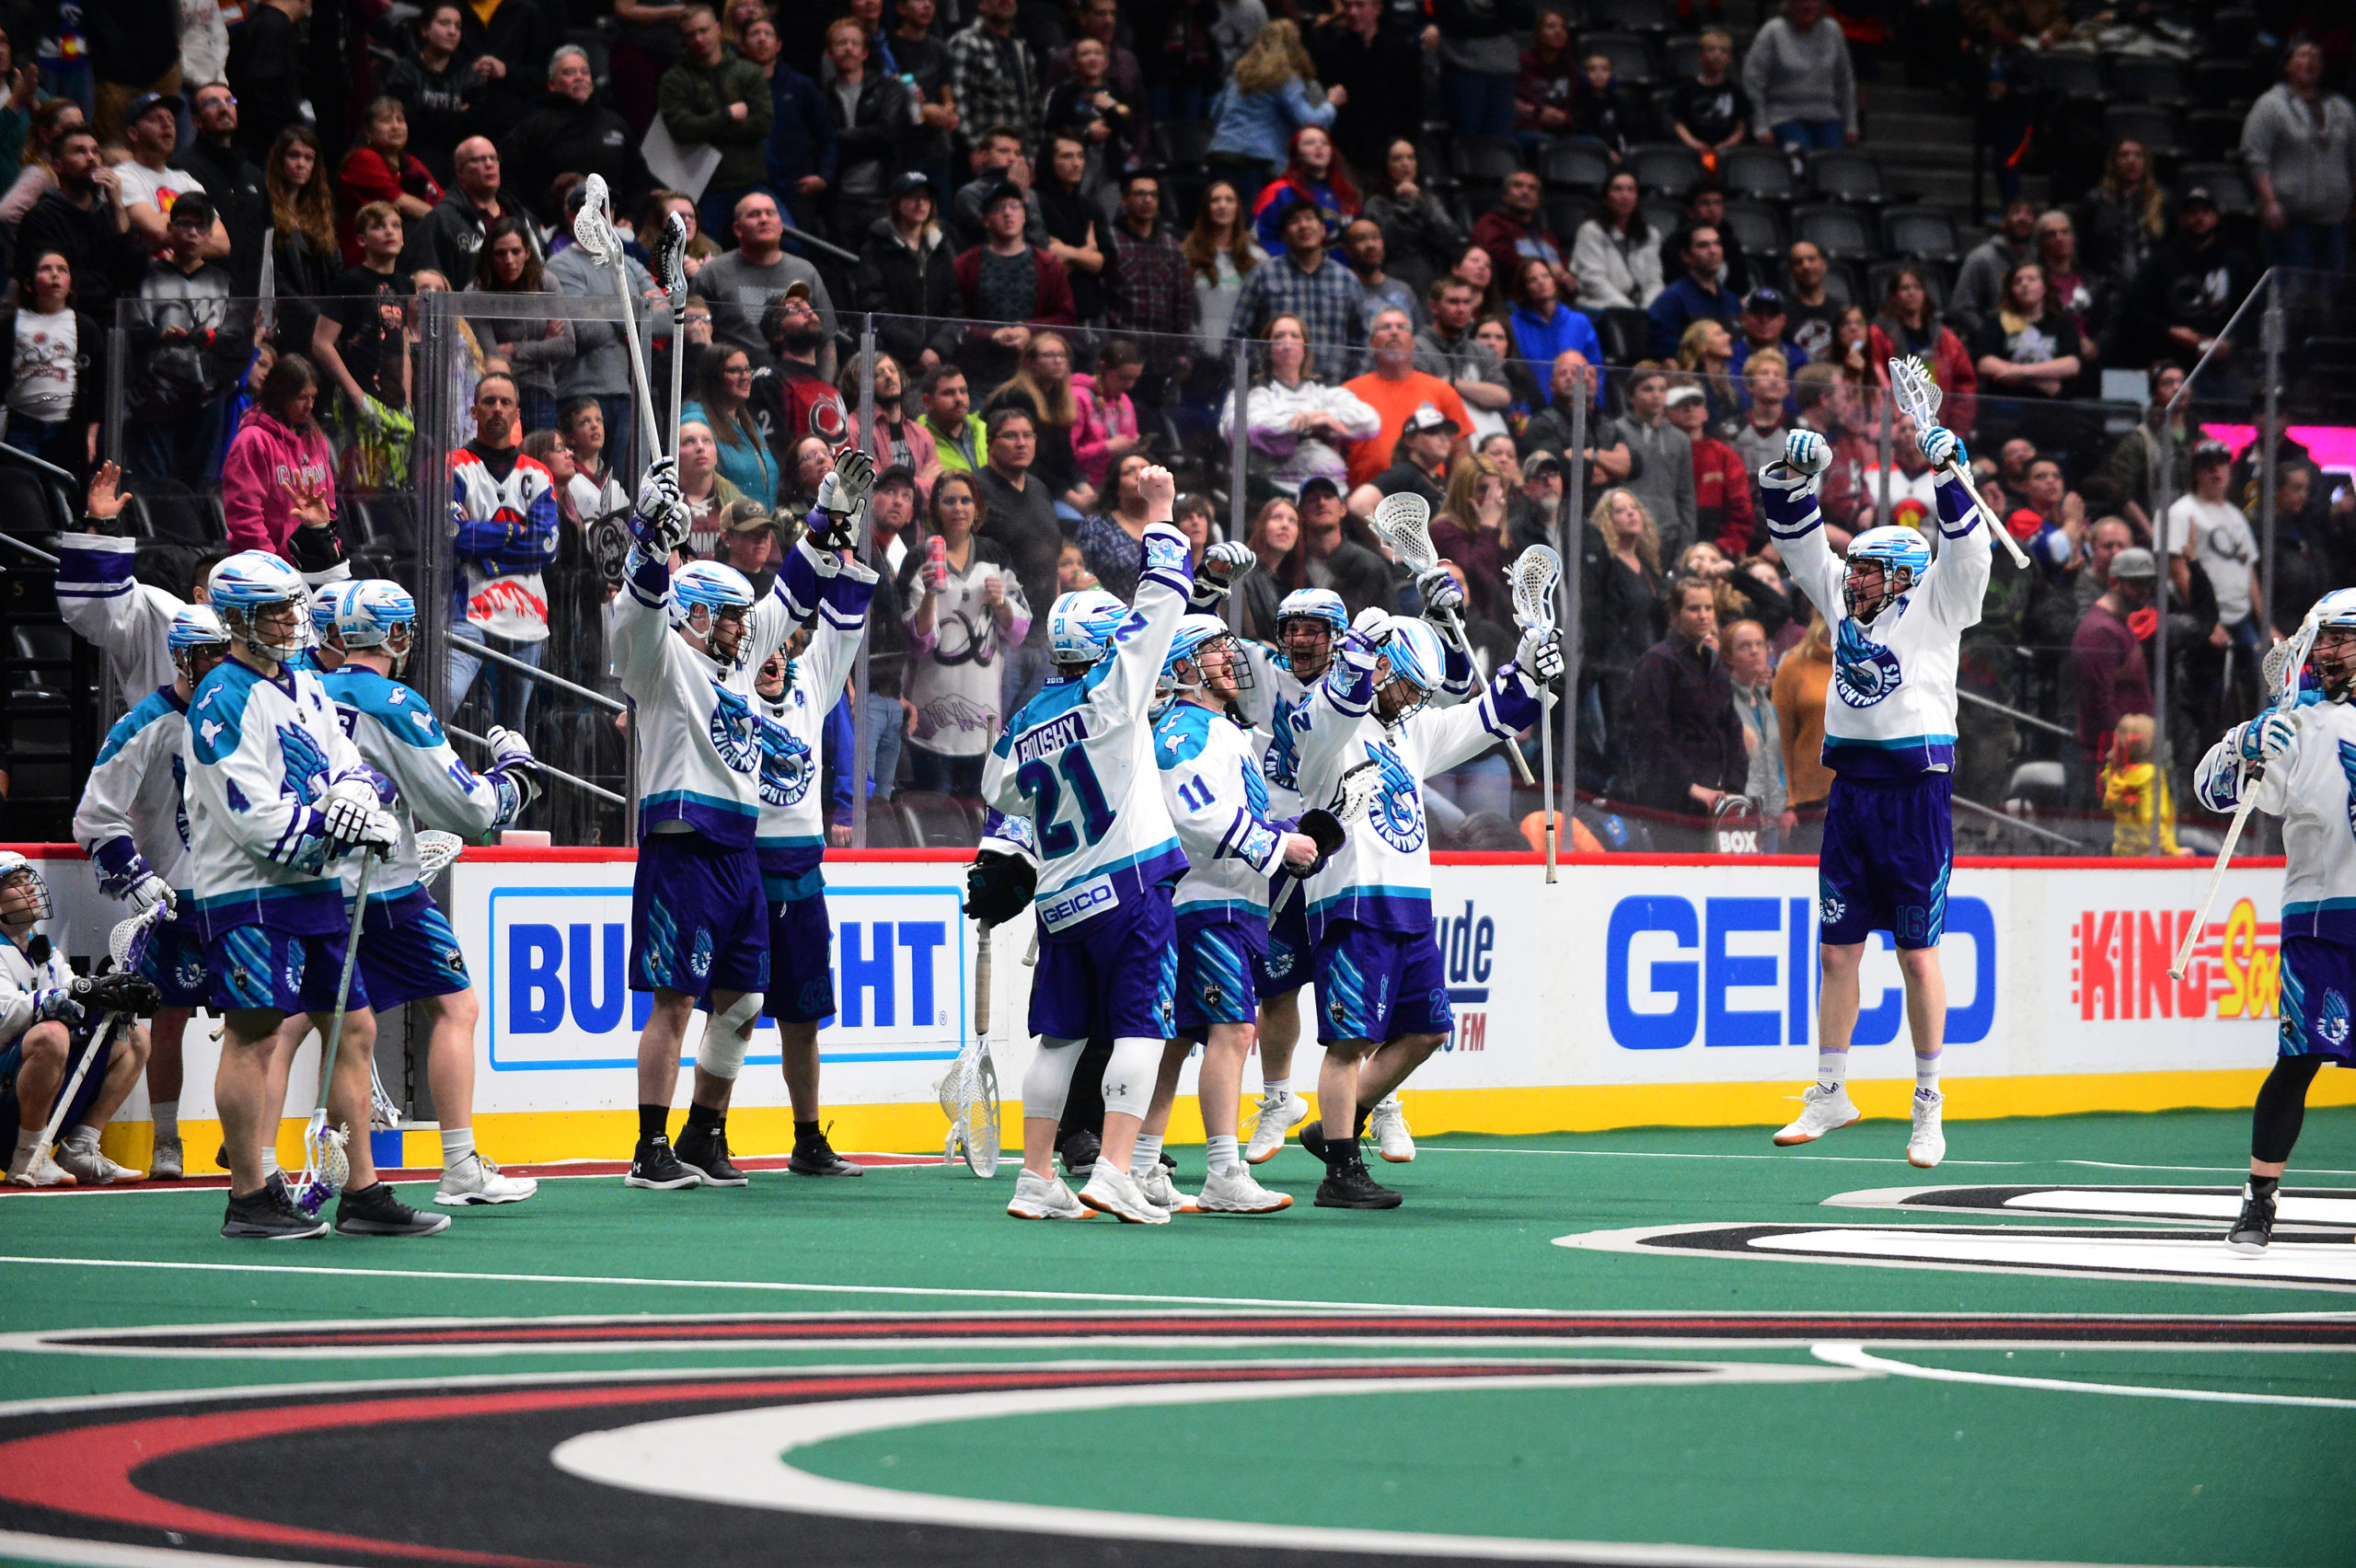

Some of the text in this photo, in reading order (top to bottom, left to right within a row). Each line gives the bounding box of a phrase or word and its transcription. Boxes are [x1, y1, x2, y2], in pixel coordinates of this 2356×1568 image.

[1054, 618, 1065, 634] 21
[226, 778, 251, 814] 4
[1015, 740, 1117, 861] 21
[1178, 774, 1217, 813] 11
[1718, 831, 1758, 853] BOX
[1042, 884, 1112, 925] GEICO
[1897, 905, 1925, 940] 16
[509, 922, 650, 1034] BU
[2081, 910, 2208, 1020] KING
[1460, 1012, 1487, 1052] FM
